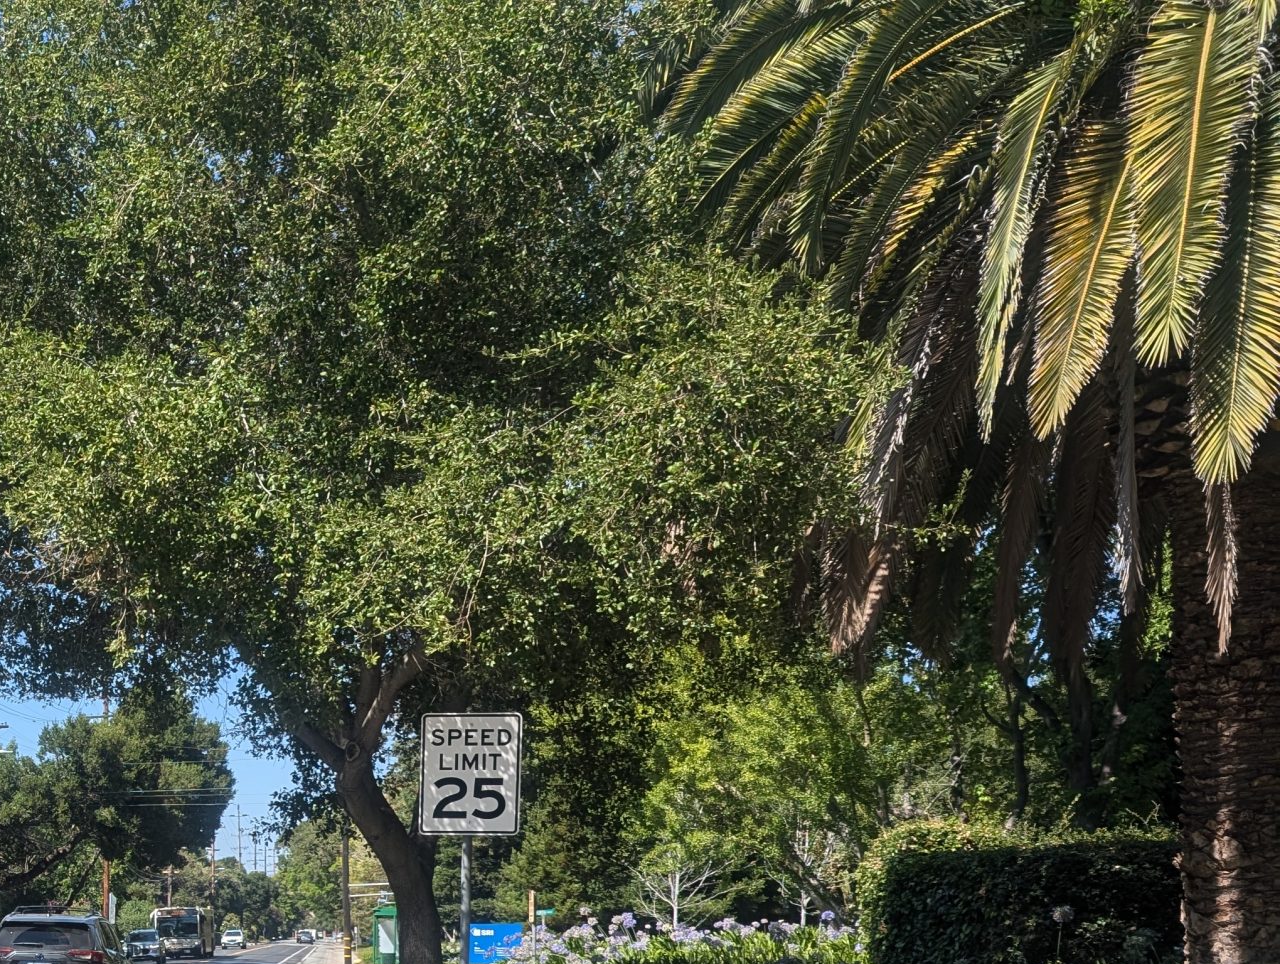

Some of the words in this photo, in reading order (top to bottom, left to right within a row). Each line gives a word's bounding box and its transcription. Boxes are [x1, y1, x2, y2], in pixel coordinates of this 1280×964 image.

[431, 728, 512, 747] SPEED
[439, 753, 502, 771] LIMIT
[432, 777, 506, 820] 25
